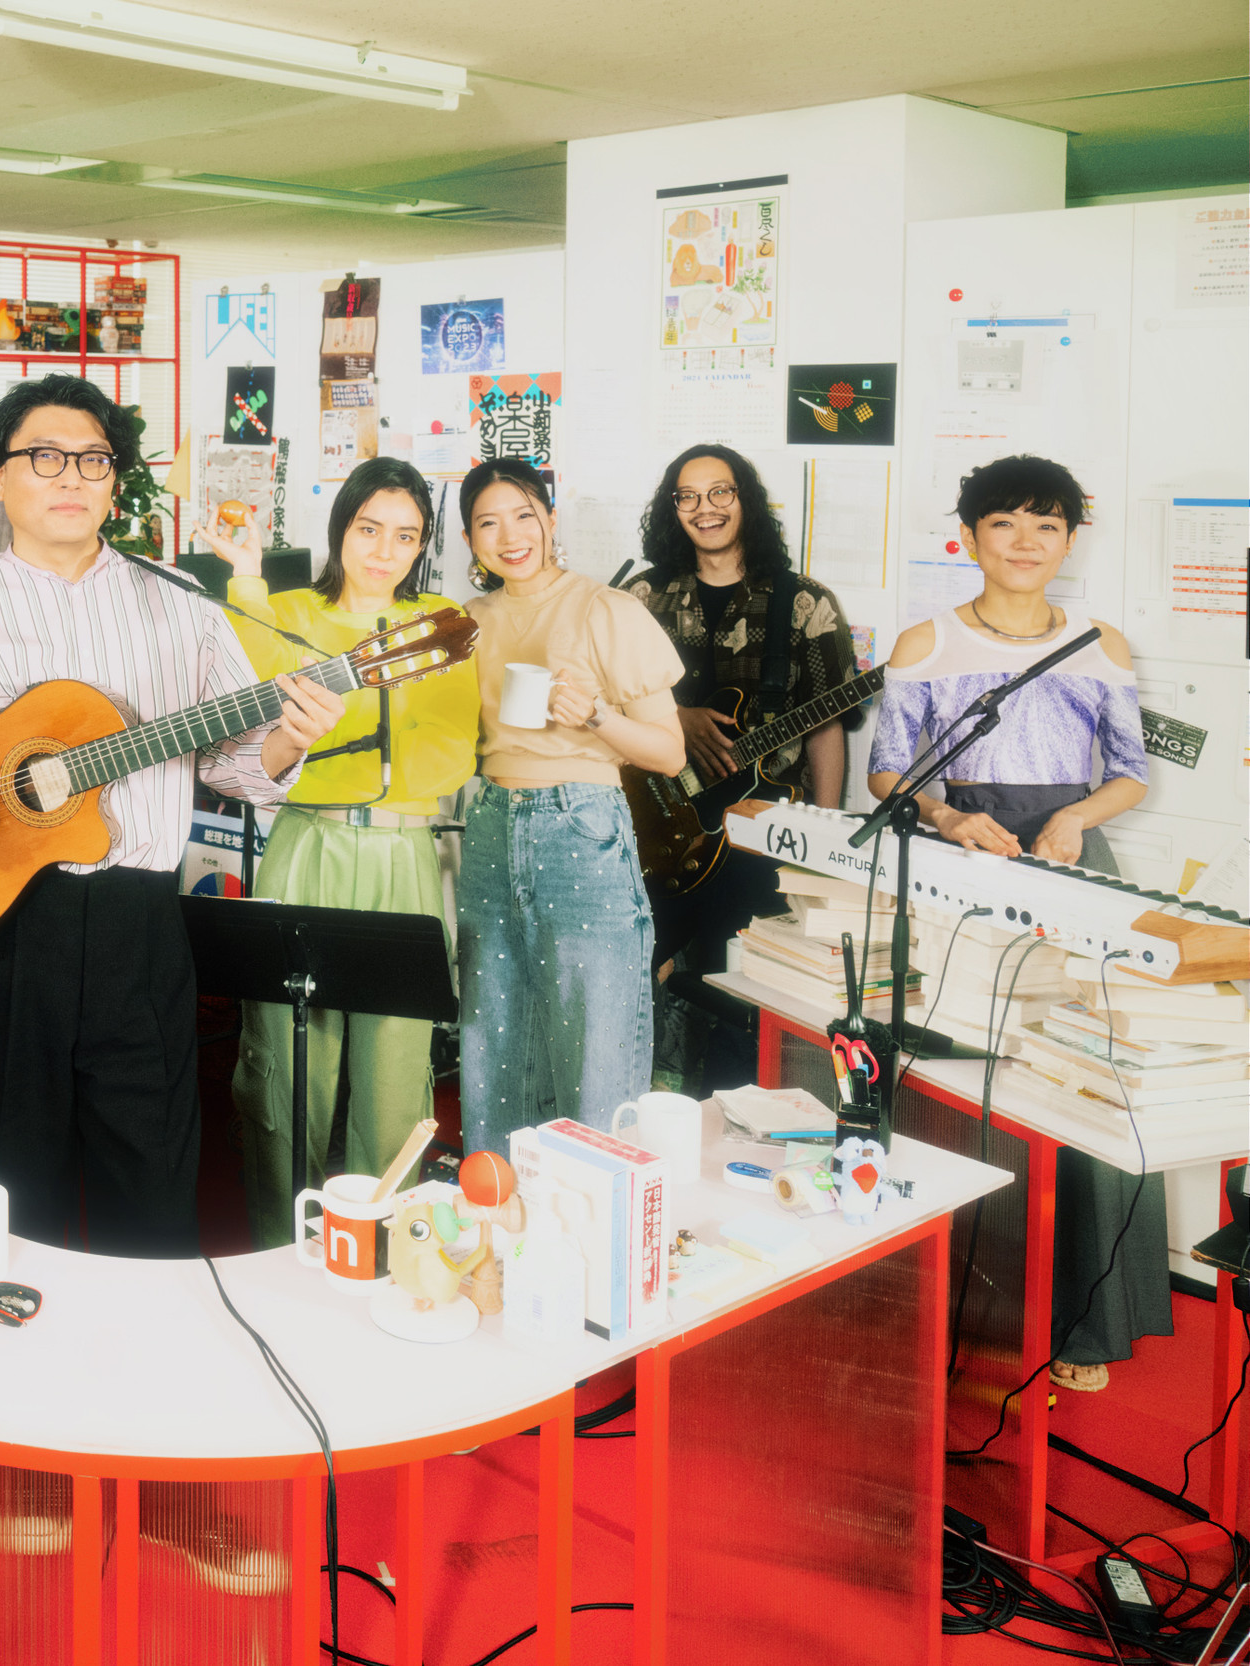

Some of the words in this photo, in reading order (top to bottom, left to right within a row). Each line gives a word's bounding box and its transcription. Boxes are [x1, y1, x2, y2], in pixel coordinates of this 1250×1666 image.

[447, 323, 476, 333] MUSIC
[447, 333, 477, 344] EXPO
[447, 343, 477, 354] 2023
[1141, 728, 1197, 758] ONGS
[828, 851, 887, 877] ARTURA
